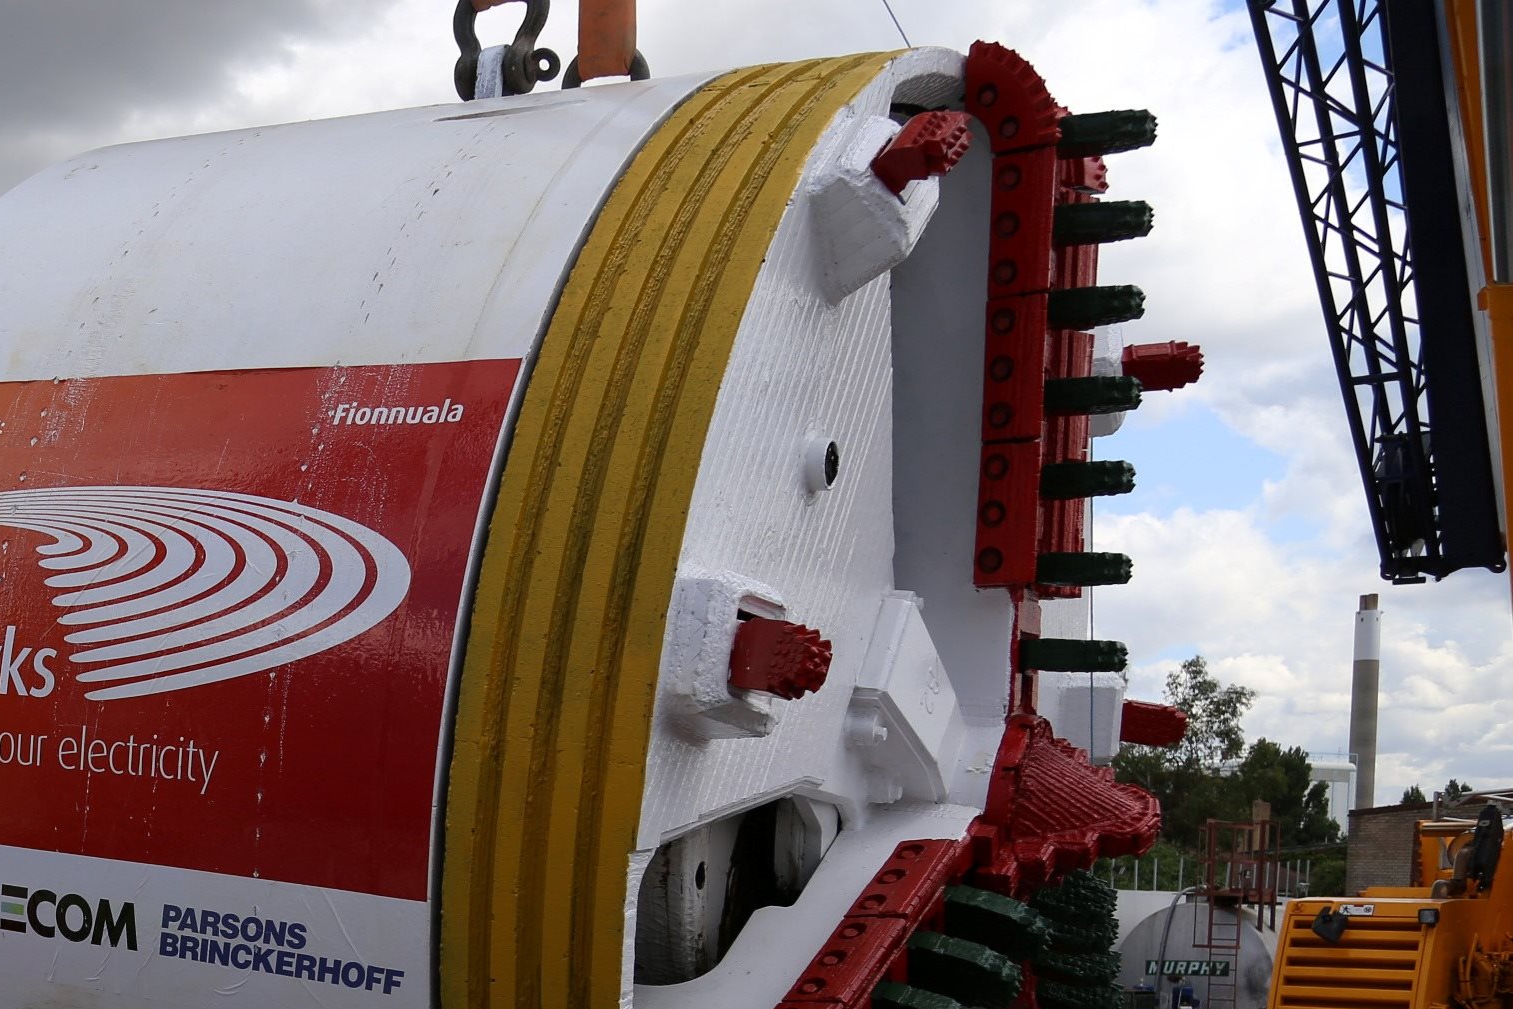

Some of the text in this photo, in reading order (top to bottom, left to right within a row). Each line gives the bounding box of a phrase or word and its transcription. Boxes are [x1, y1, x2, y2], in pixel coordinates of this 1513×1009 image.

[333, 398, 464, 425] Fionnuala
[58, 724, 219, 794] electricity
[161, 903, 308, 950] PARSONS
[159, 932, 405, 995] BRINCKERHOFF
